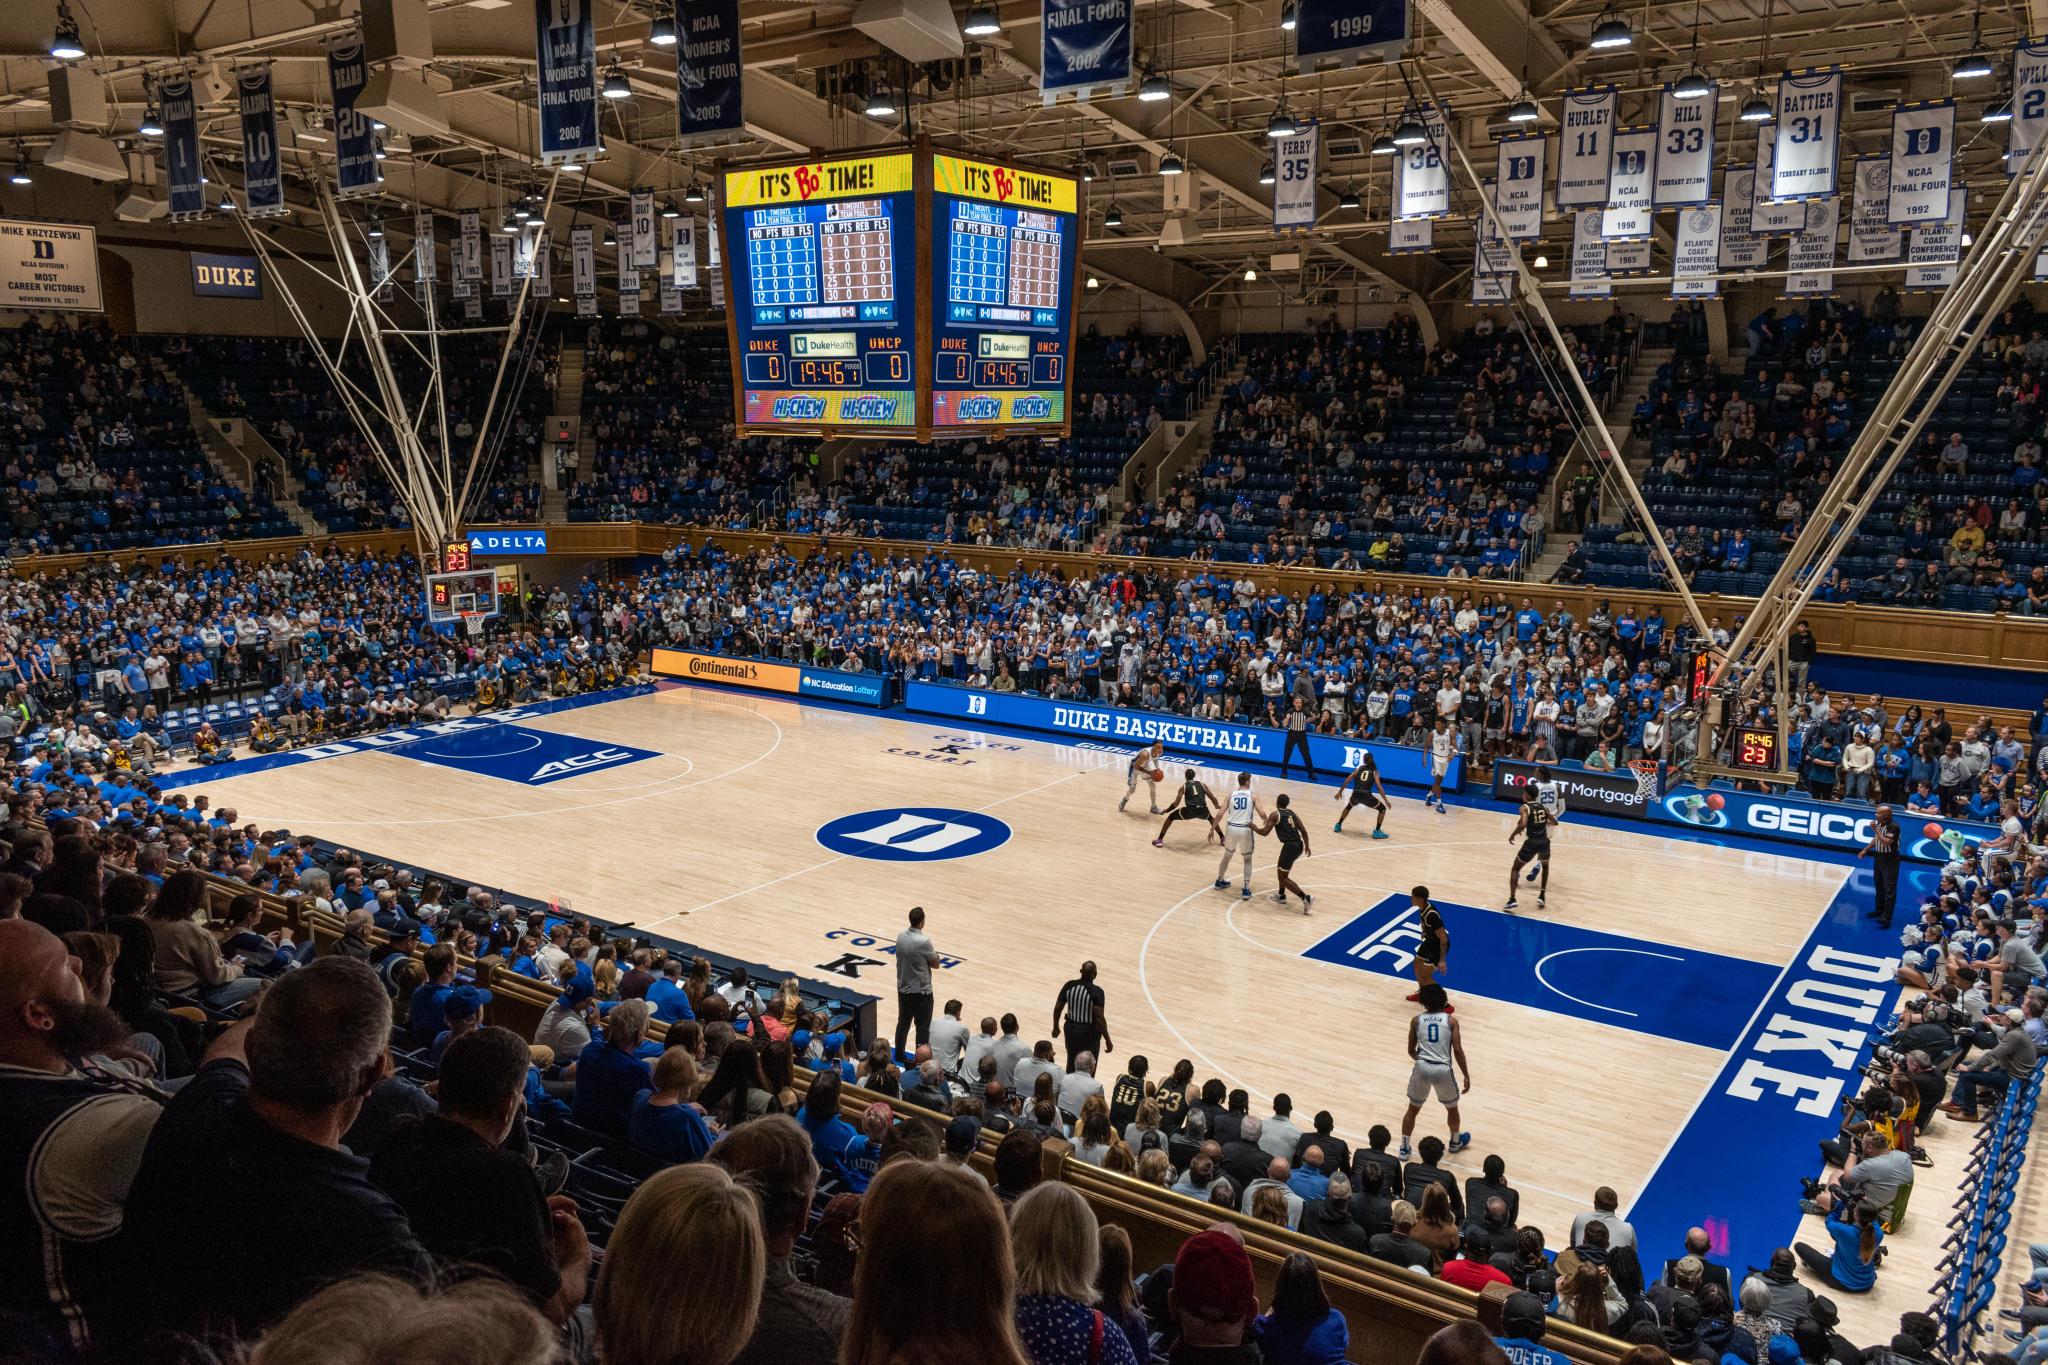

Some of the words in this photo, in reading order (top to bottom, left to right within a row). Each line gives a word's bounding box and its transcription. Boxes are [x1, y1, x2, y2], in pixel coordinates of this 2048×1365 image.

[1048, 8, 1084, 29] FINAL
[1088, 0, 1126, 22] FOUR
[693, 14, 720, 32] NCAA
[1330, 14, 1372, 38] 1999
[554, 42, 577, 58] NCAA
[684, 38, 730, 58] WOMEN'S
[1067, 54, 1100, 72] 2002
[334, 64, 362, 89] BEARD
[545, 64, 586, 82] WOMEN'S
[709, 62, 738, 80] FOUR
[542, 90, 567, 106] FINAL
[569, 88, 592, 102] FOUR
[1784, 92, 1833, 113] BATTIER
[696, 105, 721, 121] 2003
[1568, 108, 1610, 128] HURLEY
[1674, 106, 1702, 123] HILL
[339, 108, 364, 140] 20
[1790, 115, 1823, 144] 31
[560, 126, 580, 141] 2006
[247, 131, 270, 162] 10
[1282, 139, 1311, 156] FERRY
[1576, 130, 1598, 156] 11
[1666, 128, 1704, 154] 33
[178, 138, 187, 168] 1
[1410, 145, 1441, 170] 32
[1282, 158, 1310, 182] 35
[1907, 168, 1932, 177] NCAA
[760, 174, 791, 198] IT'S
[828, 164, 874, 192] TIME!
[964, 166, 990, 194] IT'S
[1018, 176, 1052, 204] TIME!
[1893, 182, 1920, 194] FINAL
[1921, 180, 1946, 192] FOUR
[1510, 190, 1529, 200] NCAA
[1618, 187, 1638, 195] NCAA
[1498, 204, 1518, 213] FINAL
[1520, 202, 1540, 212] FOUR
[1629, 199, 1650, 208] FOUR
[1906, 205, 1930, 215] 1992
[636, 218, 650, 234] 10
[824, 224, 834, 233] NO
[838, 223, 852, 232] PTS
[856, 222, 870, 230] REB
[874, 220, 888, 229] FLS
[1617, 222, 1636, 230] 1990
[1768, 216, 1788, 224] 1991
[1, 226, 24, 236] MIKE
[26, 228, 81, 240] KRZYZEWSKI
[752, 230, 762, 238] NO
[766, 229, 779, 238] PTS
[782, 228, 794, 236] REB
[799, 226, 812, 235] FLS
[1508, 224, 1527, 232] 1989
[1919, 227, 1954, 236] ATLANTIC
[1403, 234, 1420, 242] 1988
[1684, 240, 1714, 248] ATLANTIC
[1796, 236, 1829, 244] ATLANTIC
[1924, 236, 1948, 245] COAST
[1688, 248, 1708, 256] COAST
[1800, 244, 1823, 252] COAST
[1864, 247, 1885, 256] 1978
[1910, 245, 1958, 254] CONFERENCE
[1619, 256, 1637, 264] 1965
[1677, 256, 1718, 264] CONFERENCE
[1734, 254, 1752, 262] 1966
[1790, 252, 1833, 261] CONFERENCE
[1912, 254, 1956, 262] CHAMPIONS
[20, 261, 38, 269] NCAA
[38, 262, 64, 270] DIVISION
[1678, 264, 1715, 272] CHAMPIONS
[1791, 260, 1831, 269] CHAMPIONS
[34, 273, 58, 282] MOST
[196, 265, 256, 287] DUKE
[622, 278, 636, 287] 2019
[1920, 274, 1942, 282] 2006
[8, 282, 41, 291] CAREER
[42, 284, 86, 294] VICTORIES
[577, 282, 592, 292] 2015
[758, 280, 764, 290] 4
[1686, 282, 1704, 290] 2004
[1799, 279, 1818, 288] 2005
[828, 290, 838, 301] 30
[1484, 288, 1500, 297] 2002
[18, 296, 52, 304] NOVEMBER
[774, 310, 782, 319] NC
[879, 306, 888, 315] NC
[750, 340, 779, 350] DUKE
[810, 340, 854, 350] DukeHealth
[869, 337, 902, 349] UNCP
[942, 338, 968, 350] DUKE
[1038, 342, 1060, 352] UNCP
[768, 356, 780, 378] 0
[800, 361, 844, 384] 19:46
[890, 355, 902, 378] 0
[956, 356, 966, 379] 0
[1050, 358, 1058, 380] 0
[982, 362, 1016, 385] 19:46
[774, 397, 826, 419] HI-CHEW
[840, 397, 897, 419] HI-CHEW
[958, 398, 1002, 418] HI-CHEW
[1012, 398, 1052, 418] HI-CHEW
[447, 543, 468, 553] 19:46
[488, 536, 546, 548] DELTA
[448, 553, 466, 570] 23
[436, 592, 444, 602] 23
[688, 657, 749, 680] Continental
[811, 678, 821, 688] NC
[822, 679, 854, 693] Education
[854, 684, 879, 698] Lottery
[289, 708, 541, 760] DUKE
[1052, 708, 1110, 732] DUKE
[1114, 716, 1262, 755] BASKETBALL
[934, 735, 1024, 752] COACH
[1440, 742, 1446, 750] 3
[1744, 734, 1772, 747] 19:46
[530, 747, 634, 778] ACC
[887, 748, 976, 766] COURT
[1744, 748, 1766, 764] 23
[1360, 770, 1370, 782] 0
[1192, 784, 1199, 796] 1
[1571, 783, 1644, 806] Mortgage
[1234, 797, 1248, 810] 30
[1540, 791, 1555, 804] 25
[1533, 809, 1546, 824] 12
[825, 930, 962, 969] COAH
[814, 952, 888, 978] K
[1428, 1023, 1440, 1043] 0
[1726, 944, 1900, 1118] DUKE
[1116, 1085, 1138, 1106] 10
[1156, 1088, 1183, 1112] 23
